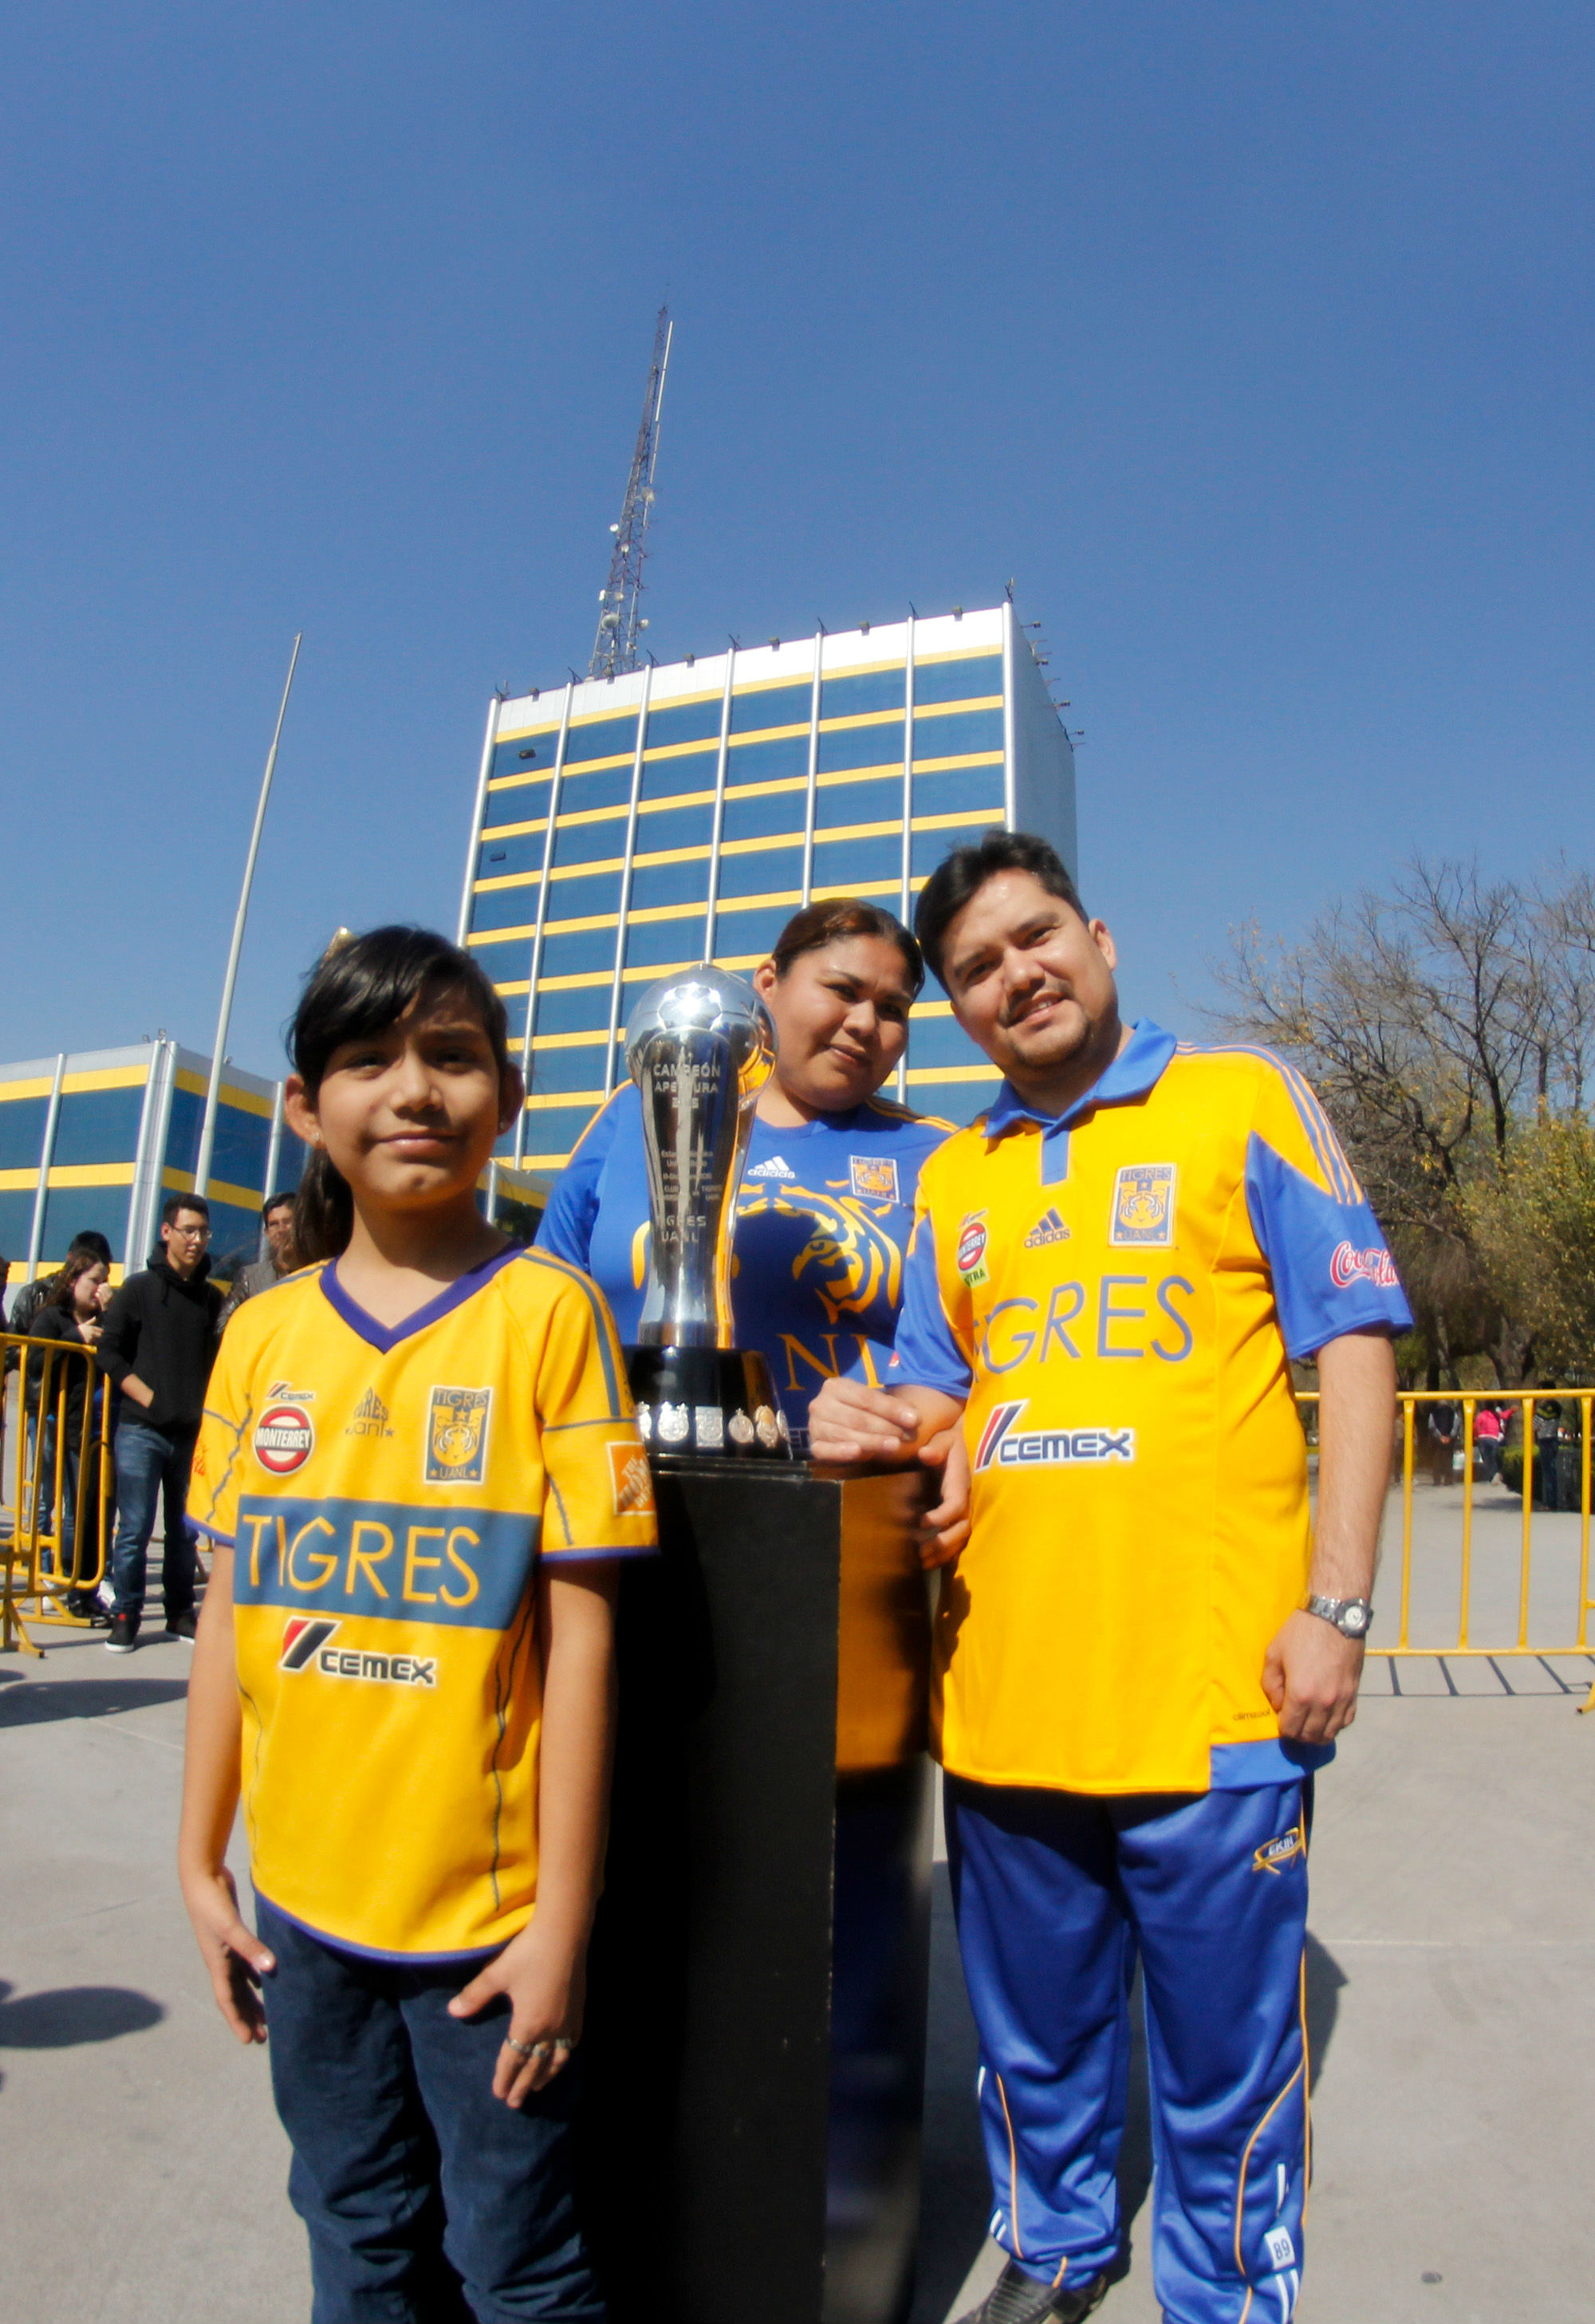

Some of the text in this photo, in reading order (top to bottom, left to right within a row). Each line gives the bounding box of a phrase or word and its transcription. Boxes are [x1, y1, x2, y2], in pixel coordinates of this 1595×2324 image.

[654, 1081, 719, 1093] APEURA
[747, 1168, 796, 1179] adidas
[1121, 1168, 1171, 1181] TIGRES
[1023, 1228, 1070, 1249] adidas
[435, 1390, 487, 1407] TIGRES
[256, 1427, 309, 1448] MONTERREY
[1000, 1433, 1130, 1463] CEMEX
[439, 1467, 469, 1479] UANL
[242, 1515, 480, 1608] TIGRES
[321, 1650, 435, 1684] CEMEX
[1273, 2238, 1291, 2260] 89
